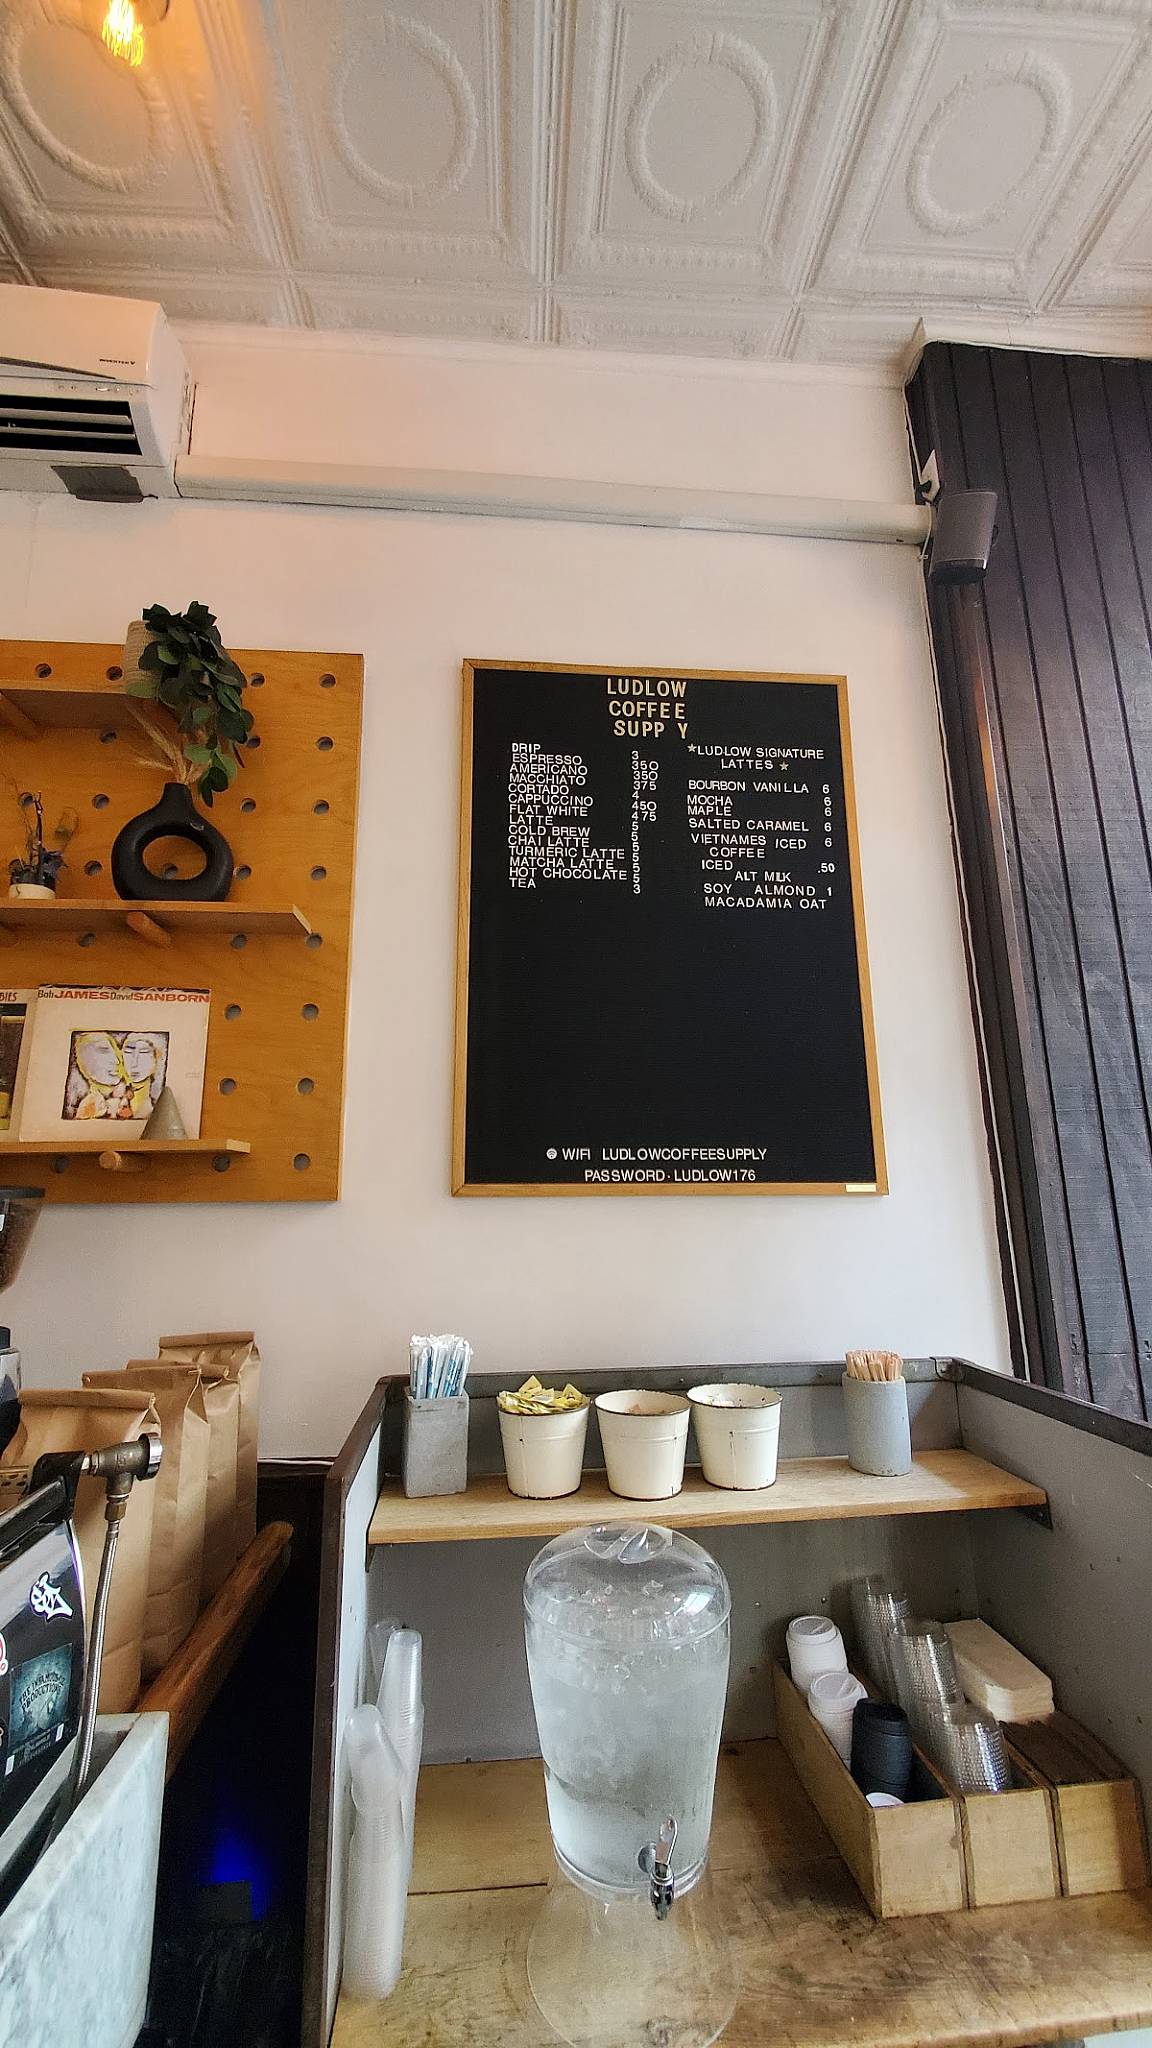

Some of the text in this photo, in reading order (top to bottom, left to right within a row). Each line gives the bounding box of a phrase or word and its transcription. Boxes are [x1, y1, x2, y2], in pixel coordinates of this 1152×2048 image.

[607, 678, 687, 698] LUDLOW
[608, 700, 685, 720] COFFEE
[512, 743, 639, 760] DRIP 3
[697, 745, 825, 759] LUDLOW SIGNATURE
[512, 753, 583, 765] ESPRESSO
[721, 758, 774, 770] LATTES
[509, 763, 588, 776] AMERICANO
[509, 773, 586, 786] MACCHIATO
[688, 779, 830, 794] BOURBON VANILLA 6
[508, 783, 639, 800] CORTADO 4
[508, 794, 594, 806] CAPPUCCINO
[687, 795, 832, 807] MOCHA 6
[509, 804, 541, 814] FLAT
[546, 806, 588, 817] WHITE
[687, 806, 832, 817] MAPLE 6
[509, 815, 639, 831] LATTE 5
[688, 818, 832, 833] SALTED CARAMEL 6
[509, 825, 639, 842] COLD BREW 5
[508, 835, 640, 852] CHAI LATTE 5
[691, 833, 832, 850] VIETNAMES ICED 6
[509, 846, 640, 862] TURMERIC LATTE 5
[709, 847, 765, 859] COFFEE
[510, 856, 640, 873] MATCHA LATTE 5
[701, 859, 733, 870] ICED
[509, 867, 640, 884] HOT CHOCOLATE 5
[734, 871, 758, 882] ALT
[509, 877, 641, 894] TEA 3
[703, 883, 832, 897] SOY ALMOND 1
[704, 896, 827, 910] MACADAMIA OAT
[54, 990, 110, 1000] JAMES
[133, 992, 210, 1003] SANBORN
[562, 1147, 767, 1161] WIFI LUDLOWCOFFEESUPPLY
